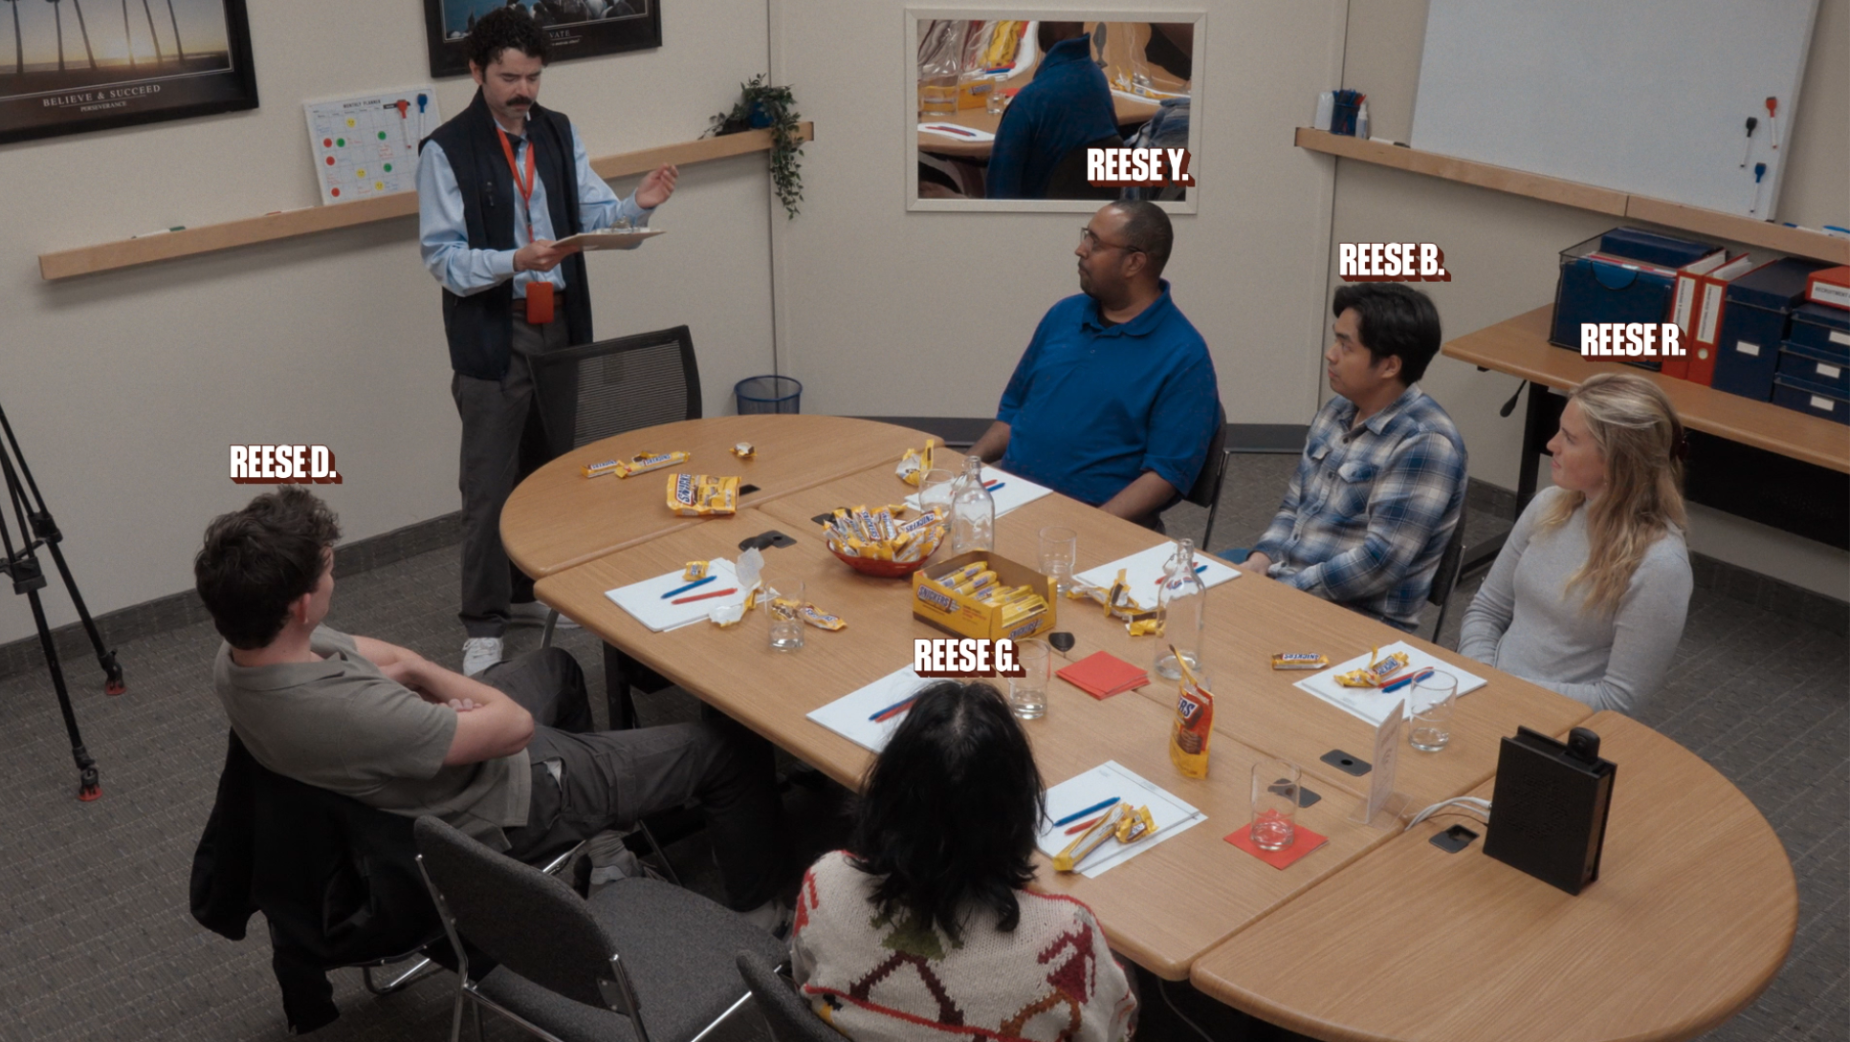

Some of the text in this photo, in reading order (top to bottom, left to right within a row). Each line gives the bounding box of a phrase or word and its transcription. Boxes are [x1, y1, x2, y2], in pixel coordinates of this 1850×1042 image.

[42, 84, 161, 108] BELIEVE & SUCCEED
[80, 100, 128, 113] PERSEVERANCE
[862, 511, 880, 539] SNICKERS
[919, 585, 951, 608] SNICKERS
